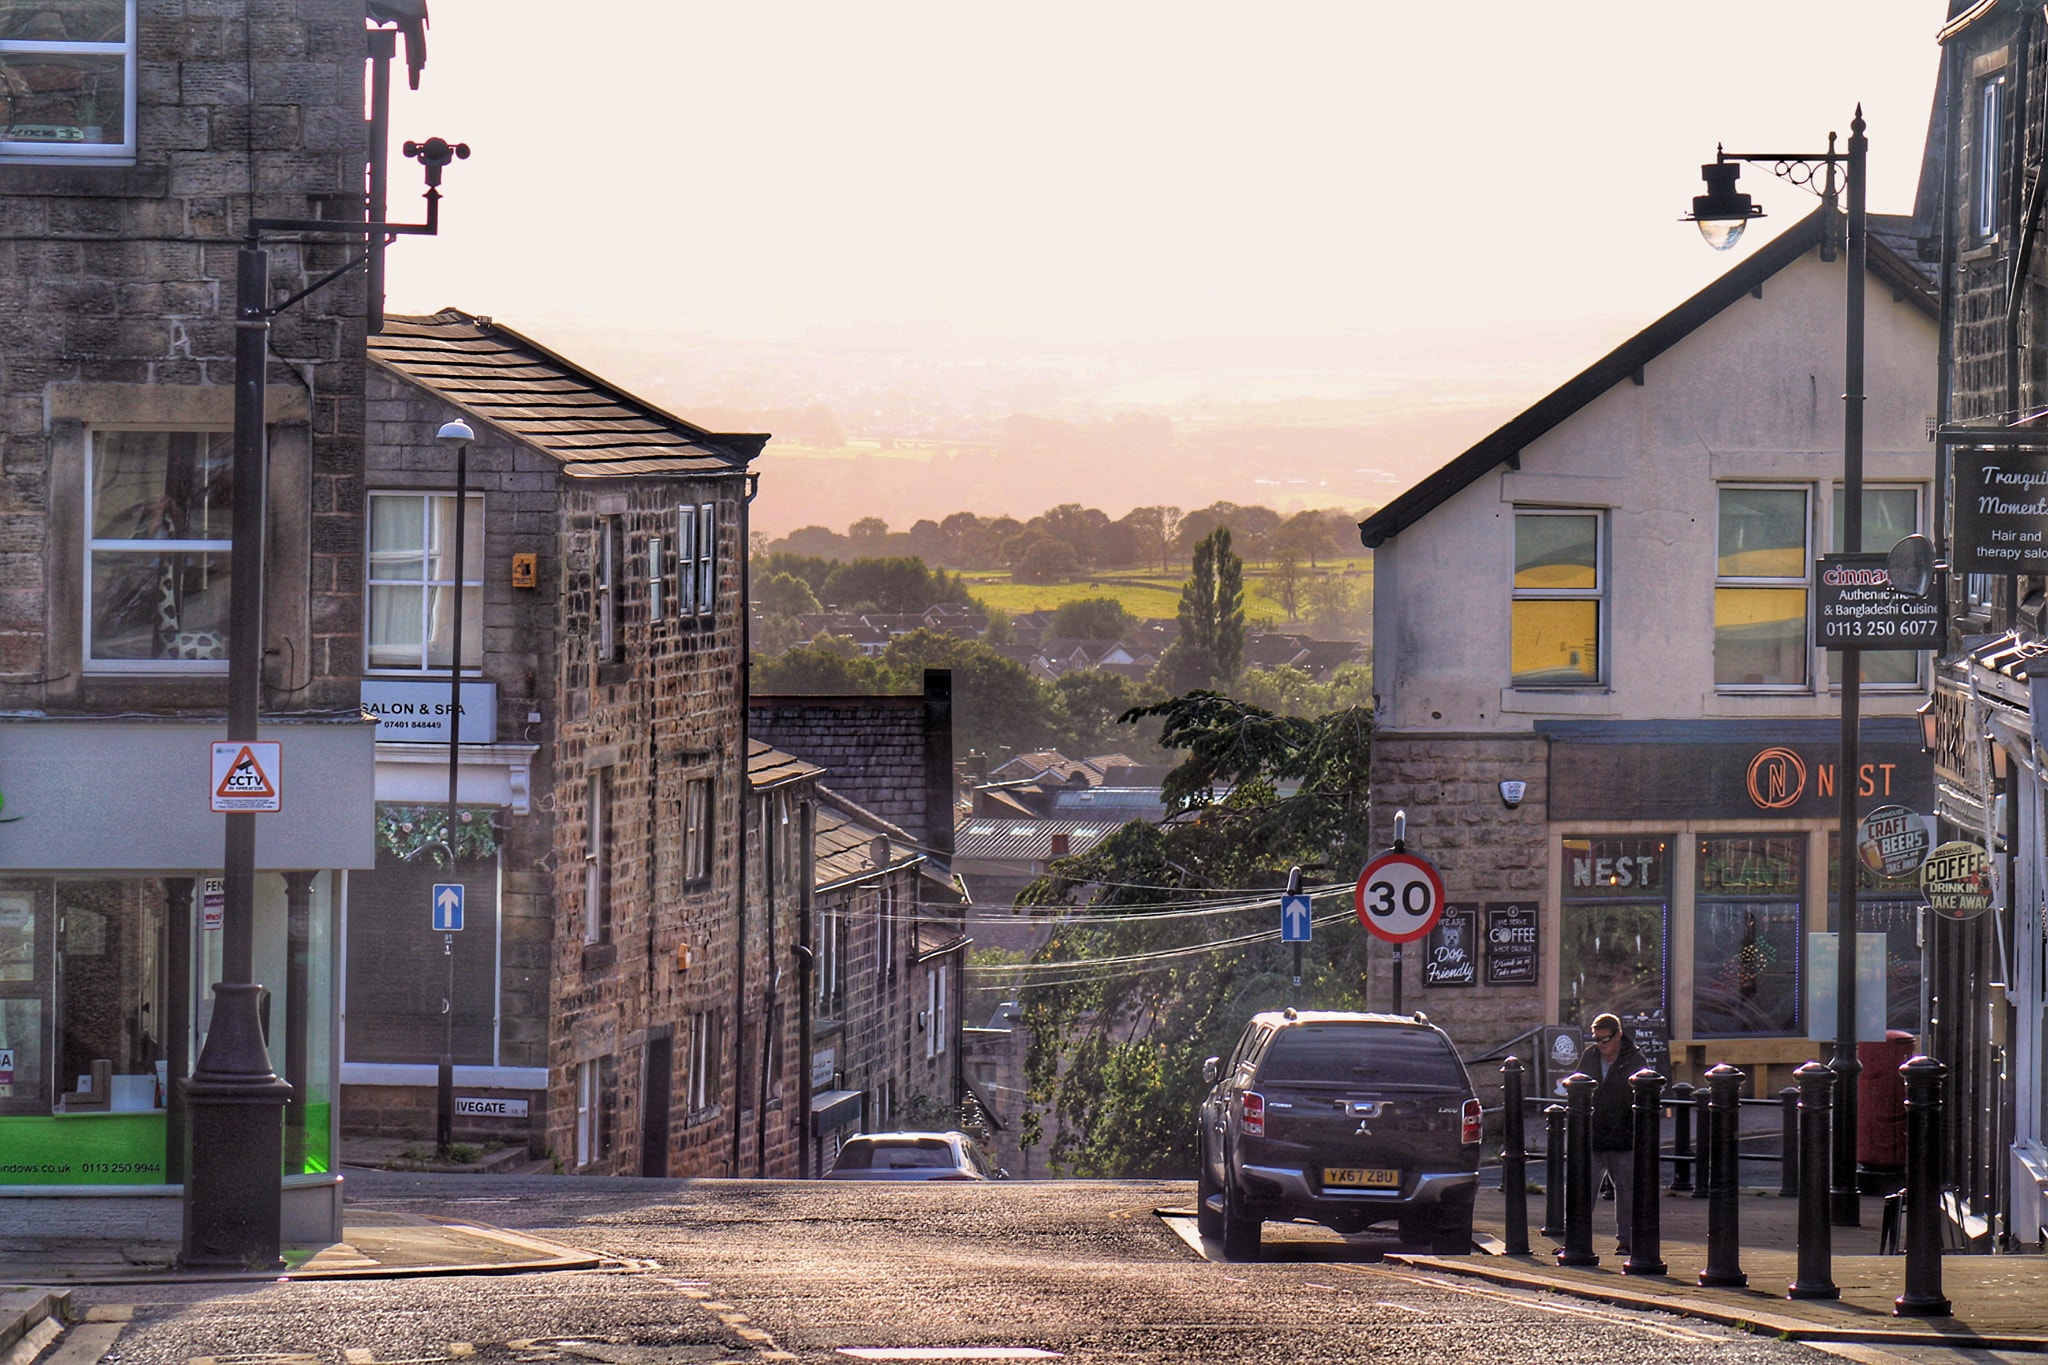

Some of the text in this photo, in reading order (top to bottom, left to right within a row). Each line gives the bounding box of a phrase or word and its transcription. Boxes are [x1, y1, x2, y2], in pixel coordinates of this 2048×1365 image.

[1992, 530, 2042, 541] Hair and
[1977, 546, 2021, 560] therapy
[1824, 604, 1833, 616] &
[1835, 603, 1899, 618] Bangladeshi
[1826, 620, 1938, 636] 0113 250 6077
[419, 704, 429, 715] &
[228, 776, 263, 785] CCTV
[1818, 764, 1896, 796] NST
[1868, 817, 1907, 839] CRAFT
[1882, 833, 1923, 854] BEERS
[1573, 856, 1653, 887] NEST
[1885, 858, 1918, 873] TAKE AWAY
[1925, 852, 1986, 883] COFFEE
[206, 881, 224, 891] FEN
[1930, 882, 1978, 893] DRINK IN
[1369, 881, 1431, 916] 30
[1930, 895, 1988, 909] TAKE AWAY
[1451, 918, 1466, 926] ARE
[1434, 946, 1467, 962] Dog
[1427, 962, 1474, 982] Friendly
[456, 1101, 506, 1113] IVEGATE
[82, 1163, 109, 1173] 0113
[112, 1163, 131, 1173] 250
[134, 1163, 160, 1173] 9944
[1330, 1170, 1393, 1183] YX67 ZBU
